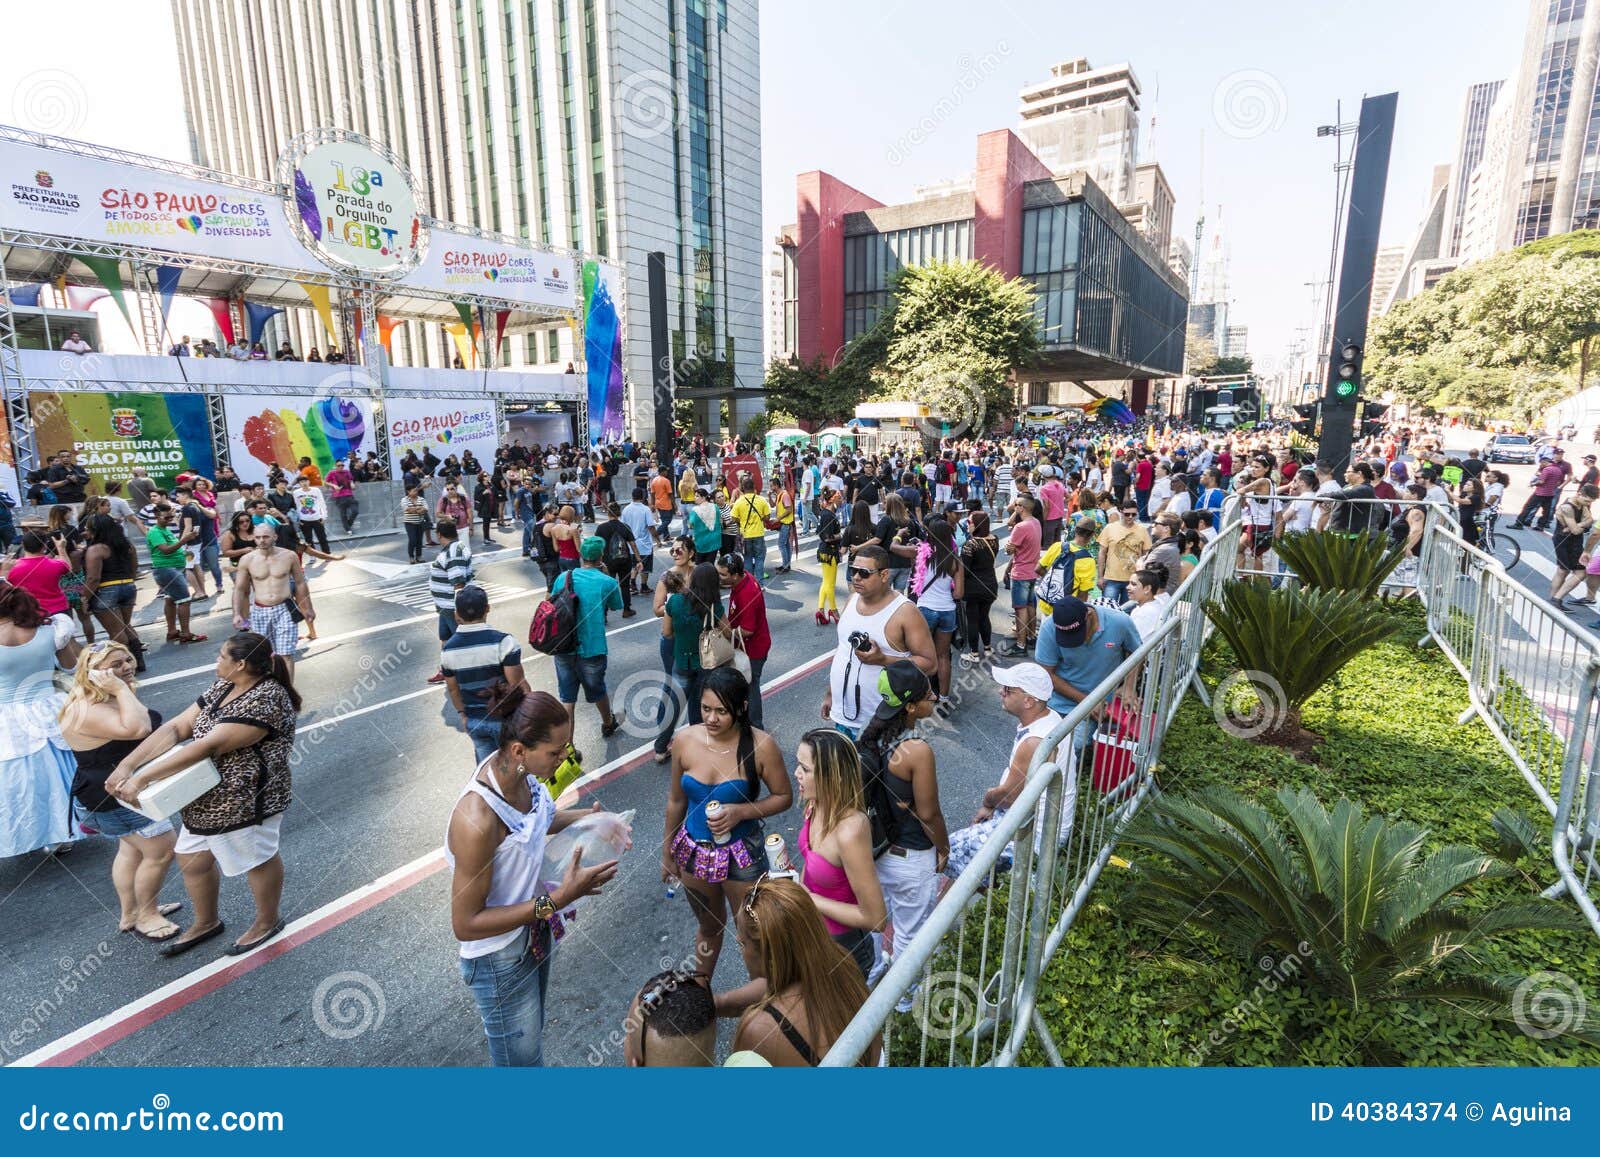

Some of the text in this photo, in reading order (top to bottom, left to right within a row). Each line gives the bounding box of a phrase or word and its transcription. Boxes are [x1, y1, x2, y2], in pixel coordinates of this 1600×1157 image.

[12, 184, 79, 201] PREFEITURA DE
[13, 191, 80, 208] SÃO PAULO
[100, 185, 218, 214] SÃO PAULO
[220, 202, 265, 216] CORES
[327, 189, 393, 213] Parada do
[104, 211, 118, 220] DE
[120, 211, 157, 221] TODOS
[255, 217, 270, 227] DA
[336, 205, 388, 225] Orgulho
[105, 220, 177, 236] AMORES
[205, 226, 272, 237] DIVERSIDADE
[327, 217, 398, 251] LGBT
[443, 250, 507, 268] SÃO PAULO
[508, 257, 534, 267] CORES
[391, 419, 421, 437] SÃO
[423, 411, 462, 432] PAULO
[463, 411, 492, 424] CORES
[74, 439, 182, 451] PREFEITURA DE
[75, 449, 184, 466] SÃO PAULO
[84, 466, 130, 474] DIREITOS
[111, 472, 165, 480] CIDANIA
